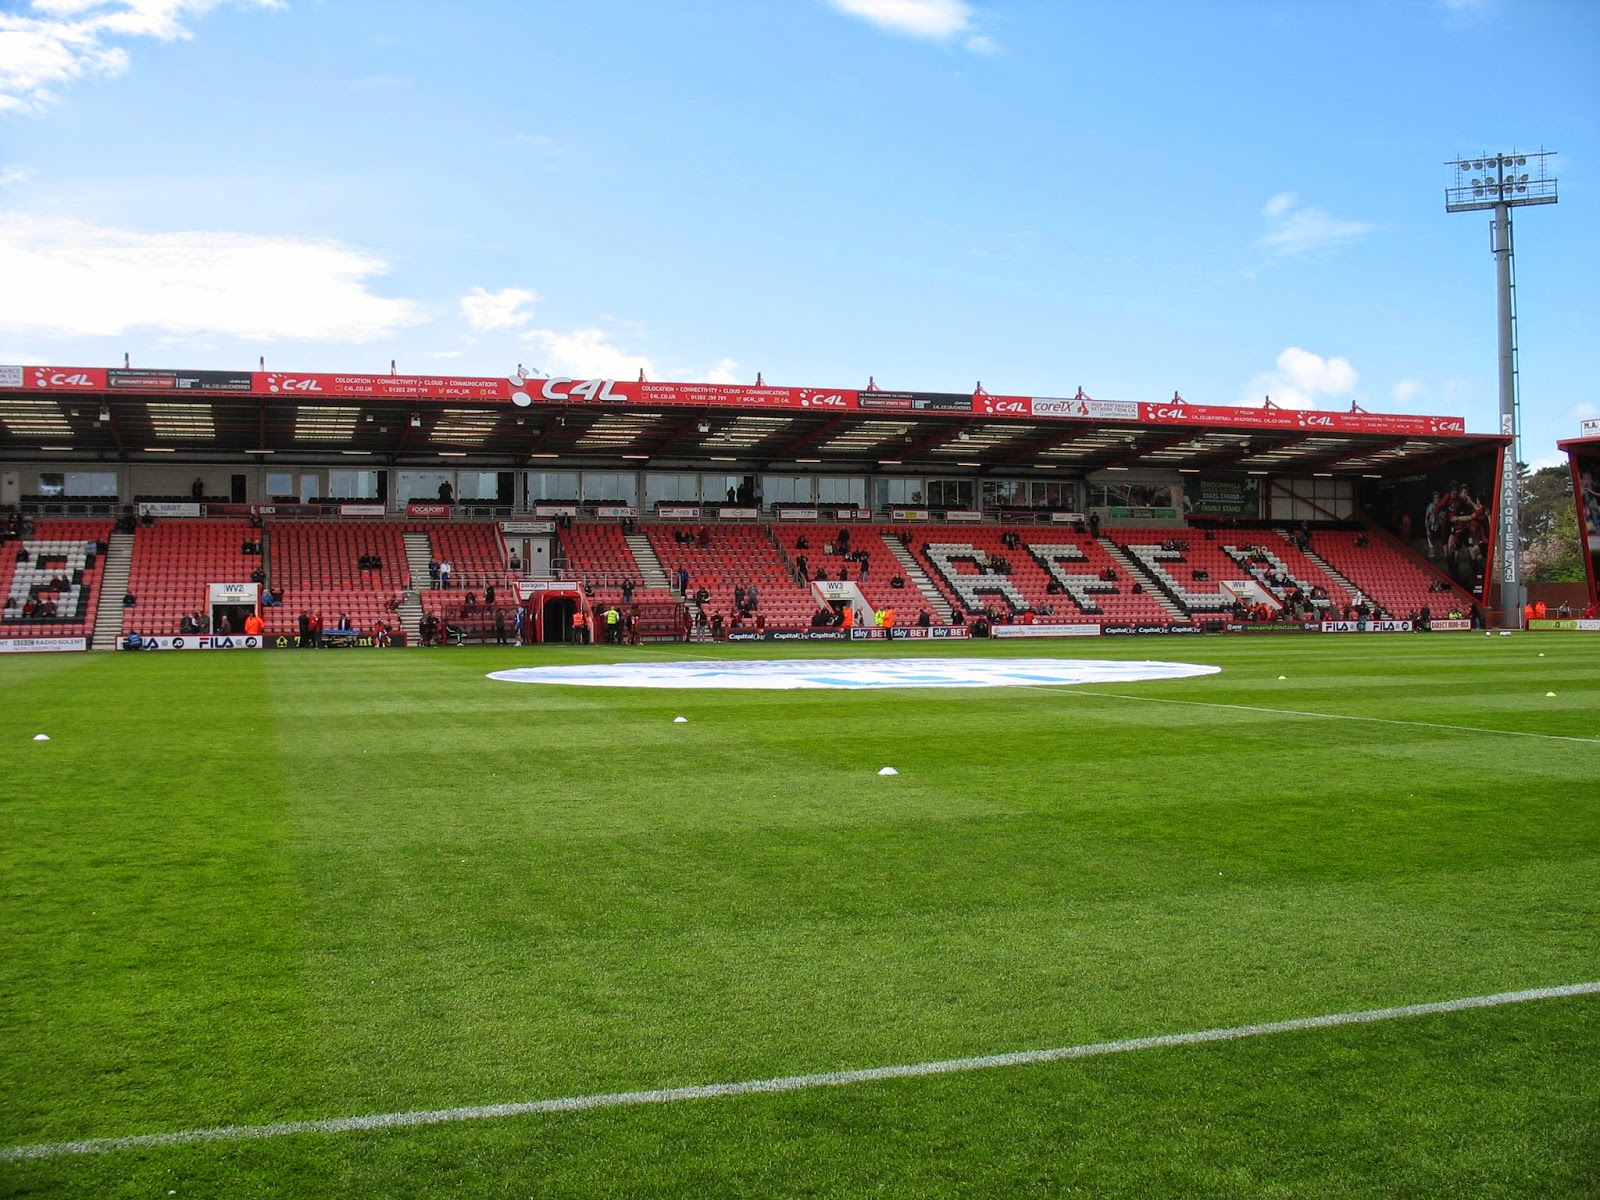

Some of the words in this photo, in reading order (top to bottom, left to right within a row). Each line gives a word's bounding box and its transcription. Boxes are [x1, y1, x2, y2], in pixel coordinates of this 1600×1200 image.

[50, 373, 94, 386] C4L
[377, 378, 417, 386] CONNECTIVITY
[282, 379, 323, 391] C4L
[541, 376, 628, 401] C4L
[812, 394, 847, 406] C4L
[996, 401, 1028, 413] C4L
[1157, 408, 1188, 419] C4L
[1307, 416, 1335, 426] C4L
[1584, 421, 1598, 429] M.A.
[1439, 422, 1464, 432] C4L
[1200, 481, 1241, 489] BROOMHILL
[1504, 446, 1514, 549] LABORATORIES
[259, 506, 276, 514] BLACK
[1505, 561, 1514, 581] ACS
[225, 584, 244, 592] WV2
[1325, 622, 1349, 631] FILA
[1373, 622, 1395, 631] FILA
[1431, 621, 1448, 629] DIRECT
[854, 629, 868, 638] sky
[871, 629, 887, 637] BET
[893, 629, 907, 638] sky
[910, 629, 927, 637] BET
[934, 628, 948, 637] sky
[950, 628, 968, 636] BET
[199, 637, 234, 649] FILA
